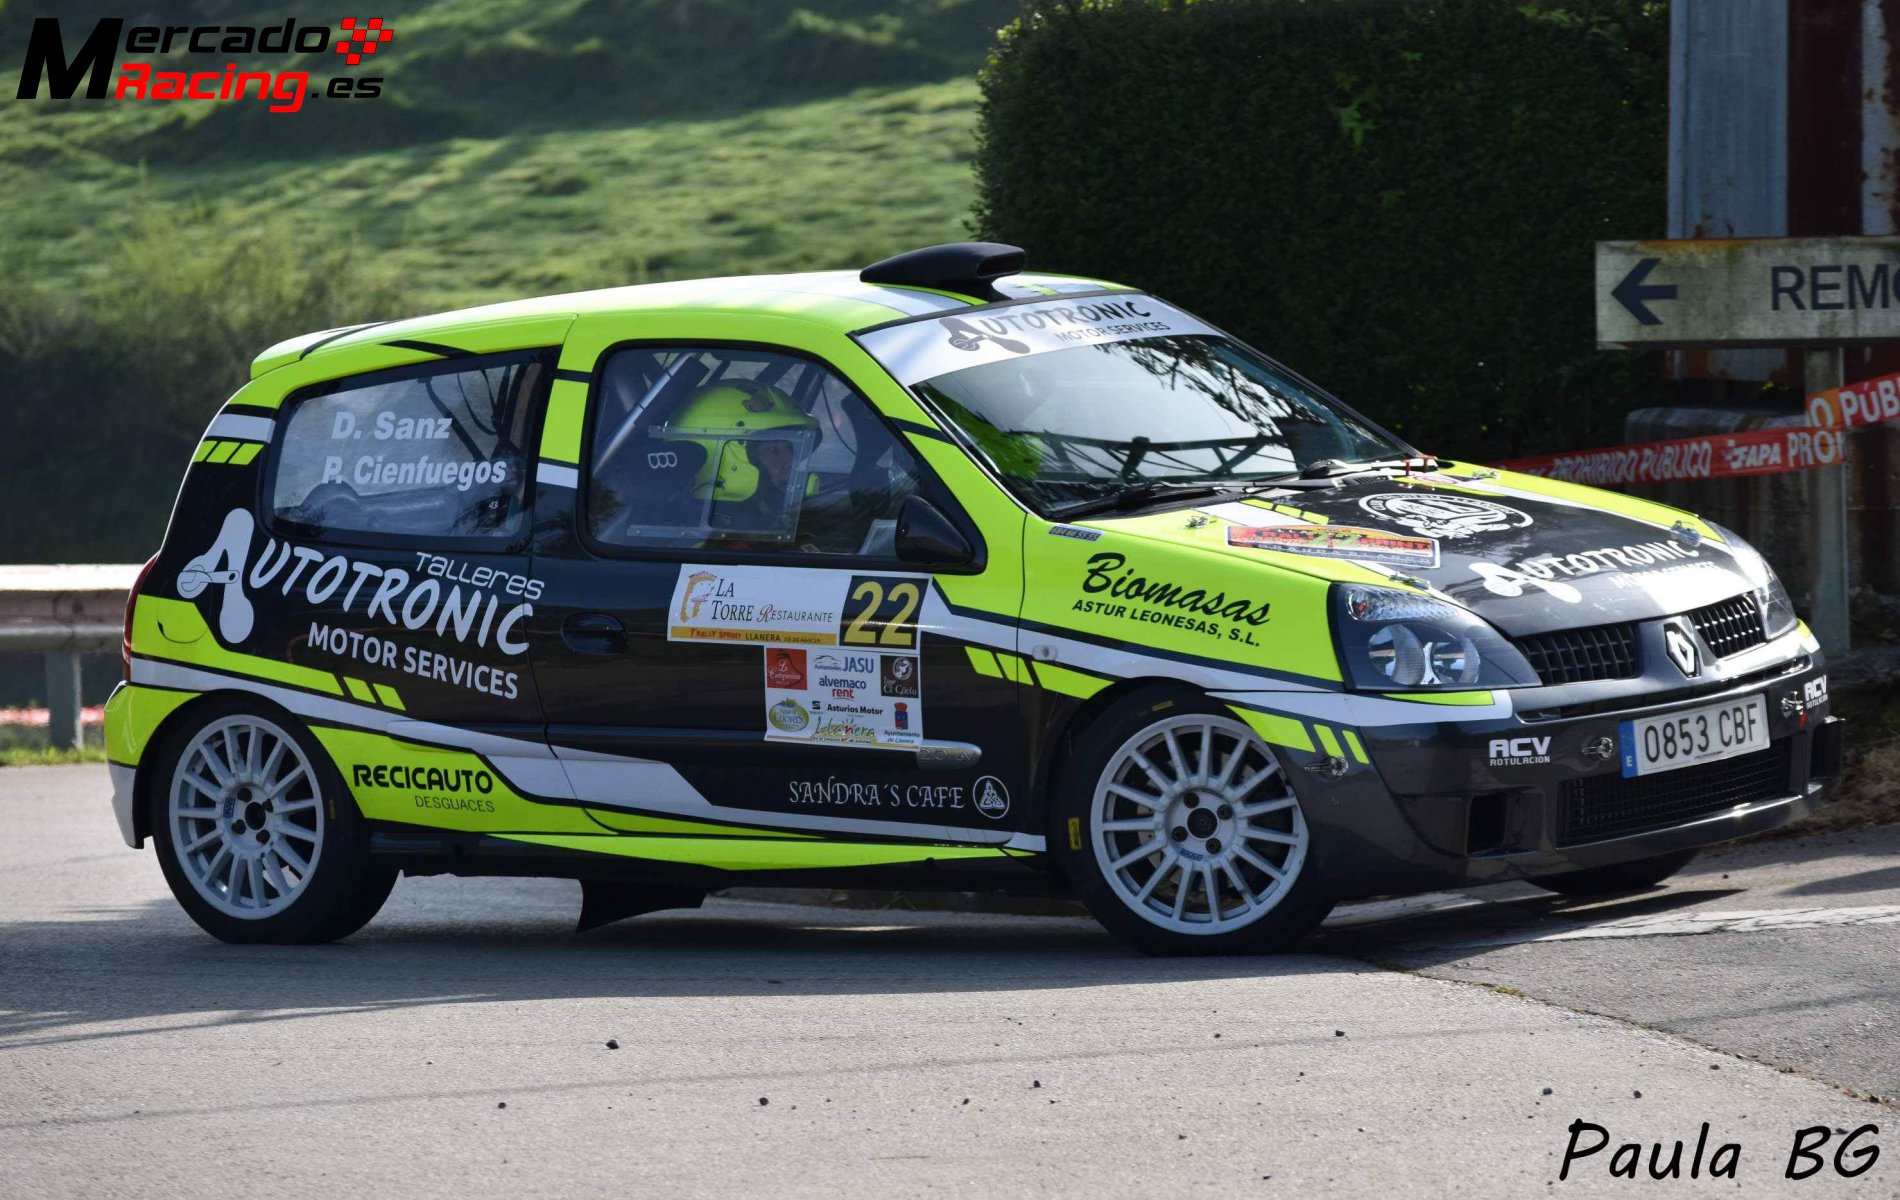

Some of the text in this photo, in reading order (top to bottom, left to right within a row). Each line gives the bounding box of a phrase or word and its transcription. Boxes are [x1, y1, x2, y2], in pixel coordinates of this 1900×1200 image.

[1771, 263, 1900, 311] REM
[939, 301, 1151, 354] AUTOTRONIC
[1054, 320, 1171, 342] MOTOR SERVICES
[1838, 376, 1900, 427] PÚB
[331, 411, 452, 440] D. Sanz
[322, 455, 507, 491] P. Cienfuegos
[1640, 440, 1713, 481] PÚBLICO
[177, 508, 533, 655] AUTOTRONIC
[1468, 540, 1699, 604] AUTOTRONIC
[715, 578, 734, 598] LA
[1082, 552, 1271, 626] Biomasas
[711, 601, 755, 622] TORRE
[844, 581, 920, 645] 22
[1072, 599, 1260, 647] ASTUR LEONESAS, S.L.
[745, 632, 781, 642] LLANERA
[307, 622, 518, 700] MOTOR SERVICES
[843, 656, 875, 674] JASU
[819, 675, 867, 690] alvemaco
[832, 688, 855, 699] rent
[827, 703, 859, 714] Asturias
[859, 706, 884, 716] Motor
[1489, 736, 1551, 758] ACV
[1644, 703, 1758, 763] 0853 CBF
[1489, 755, 1551, 766] ROTULACION
[1626, 755, 1633, 768] E
[352, 764, 494, 794] RECICAUTO
[414, 795, 496, 813] DESGUACES
[906, 785, 965, 809] CAFE
